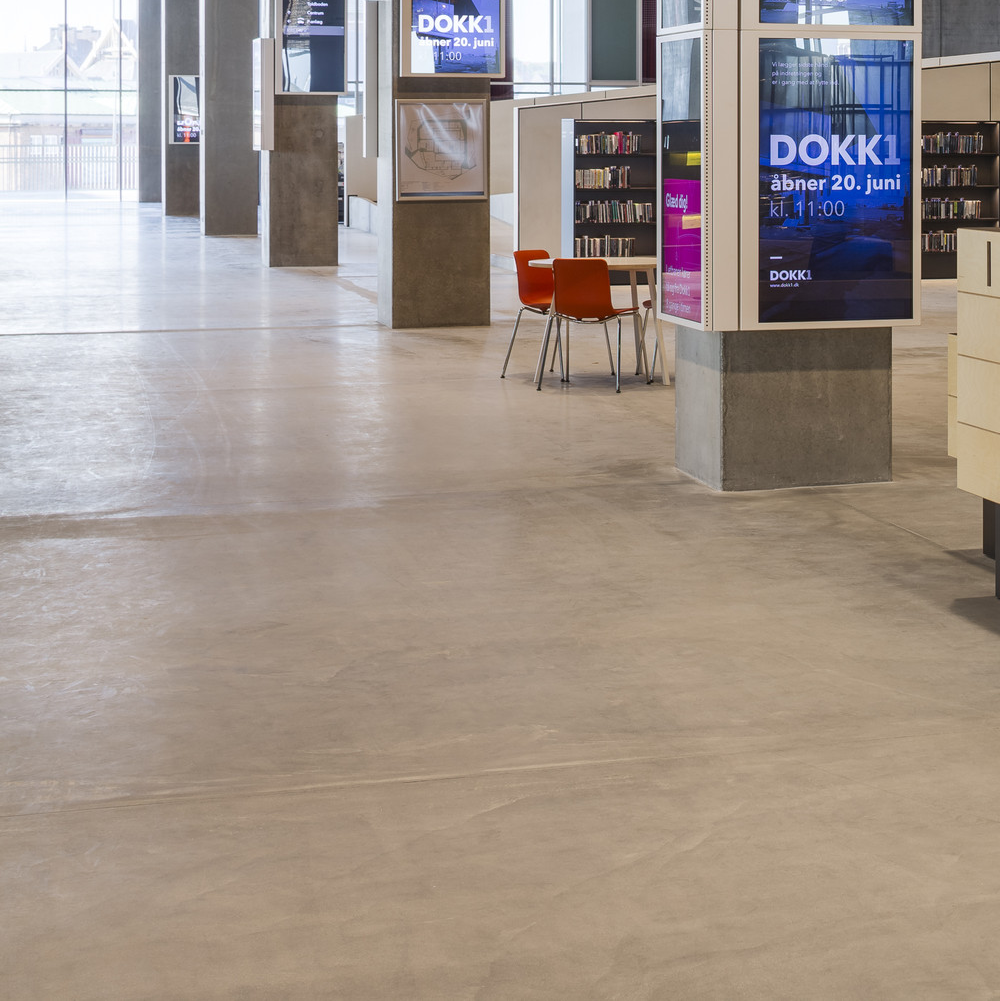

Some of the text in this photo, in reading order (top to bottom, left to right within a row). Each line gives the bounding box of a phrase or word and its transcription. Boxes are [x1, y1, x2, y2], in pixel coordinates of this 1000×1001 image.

[418, 14, 494, 33] DOKK1
[420, 36, 494, 49] åbner 20. juni
[434, 51, 462, 61] 11:00
[770, 134, 900, 166] DOKK1
[770, 174, 901, 195] åbner 20. juni
[665, 192, 688, 213] Glæd dig!
[770, 200, 845, 217] kl. 11:00
[770, 270, 812, 281] DOKK1
